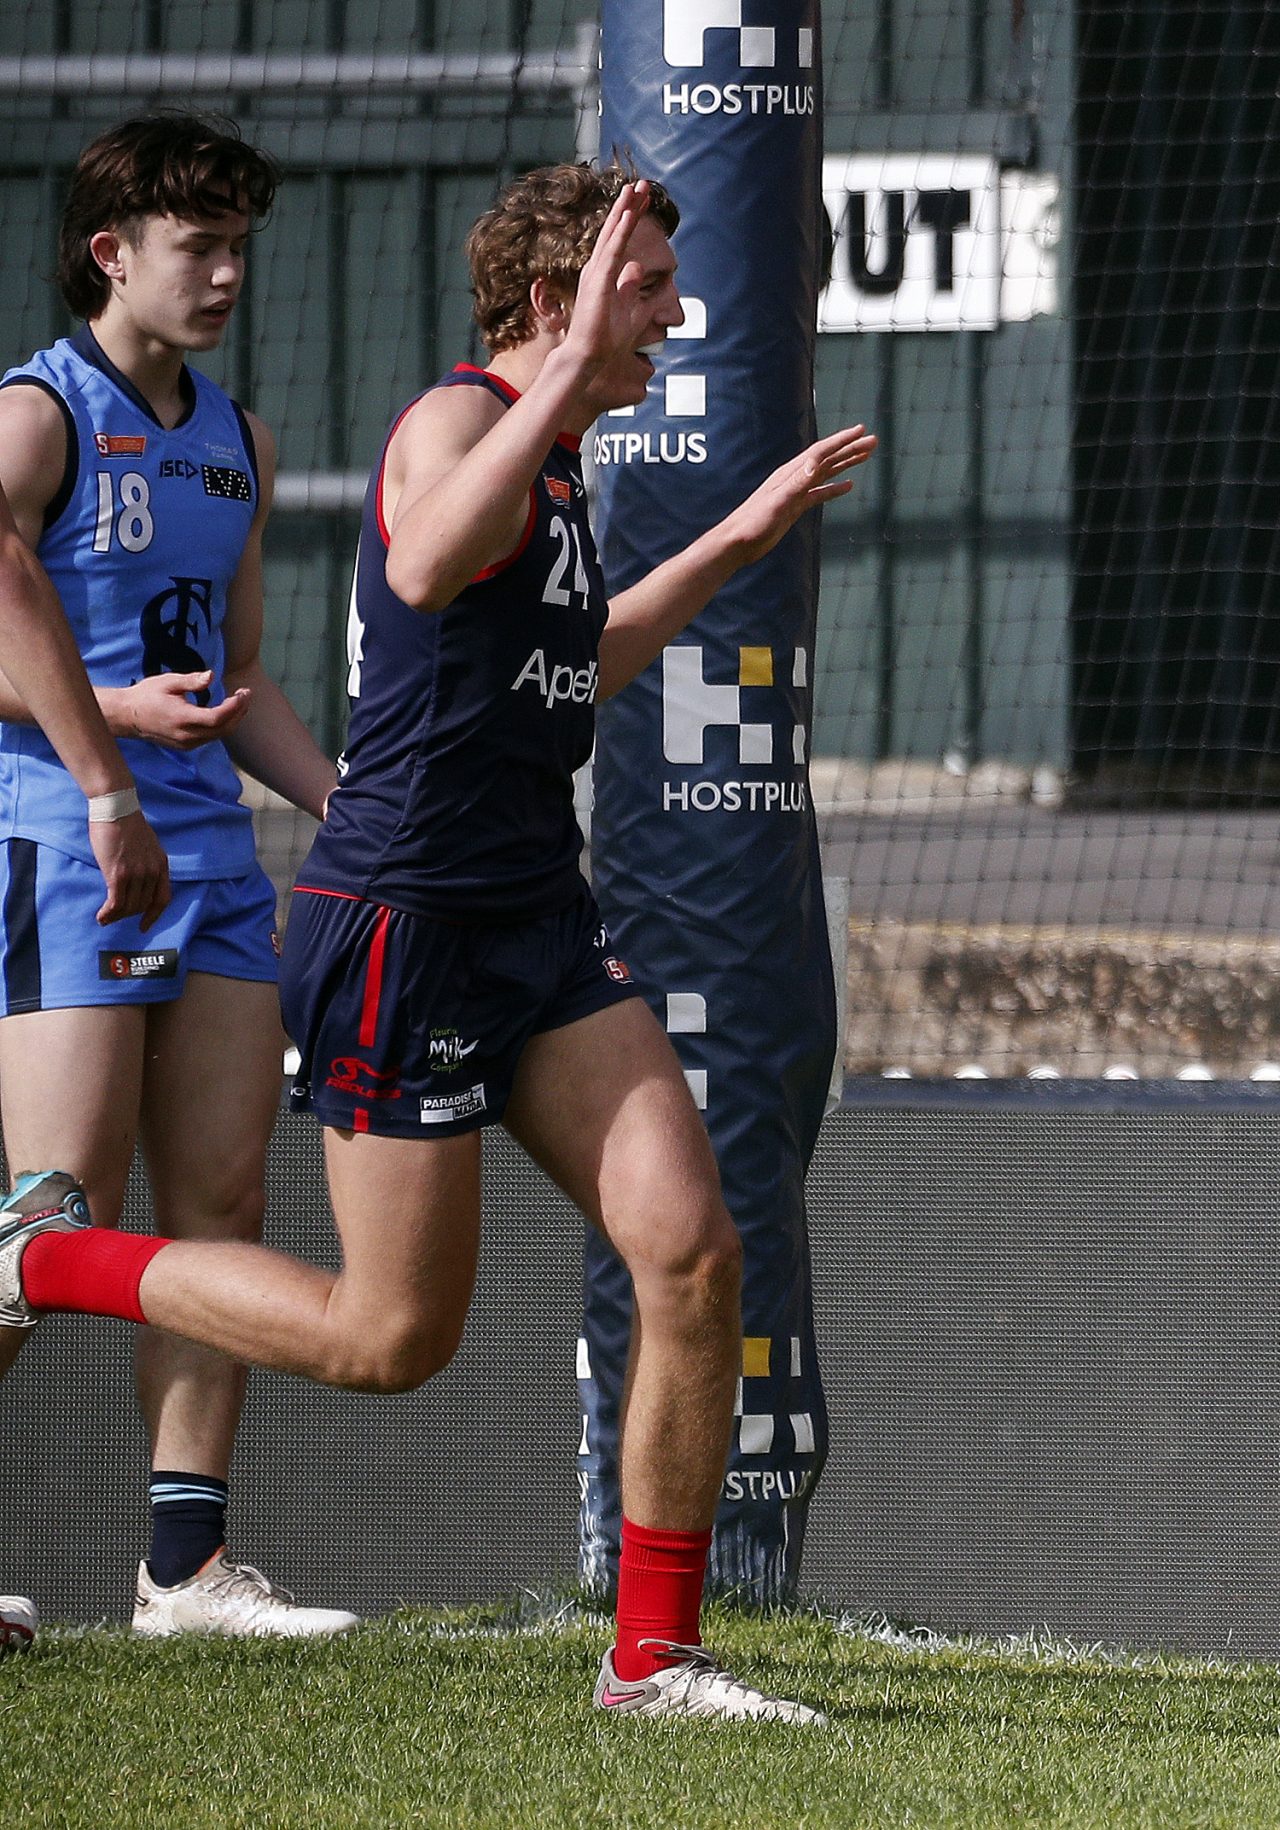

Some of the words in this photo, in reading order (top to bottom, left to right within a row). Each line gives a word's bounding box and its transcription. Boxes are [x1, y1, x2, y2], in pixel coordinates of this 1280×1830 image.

[663, 84, 814, 115] HOSTPLUS
[92, 470, 155, 553] 18
[130, 955, 166, 967] STEELE
[423, 1091, 472, 1109] PARADISE
[719, 1470, 812, 1501] STPLU
